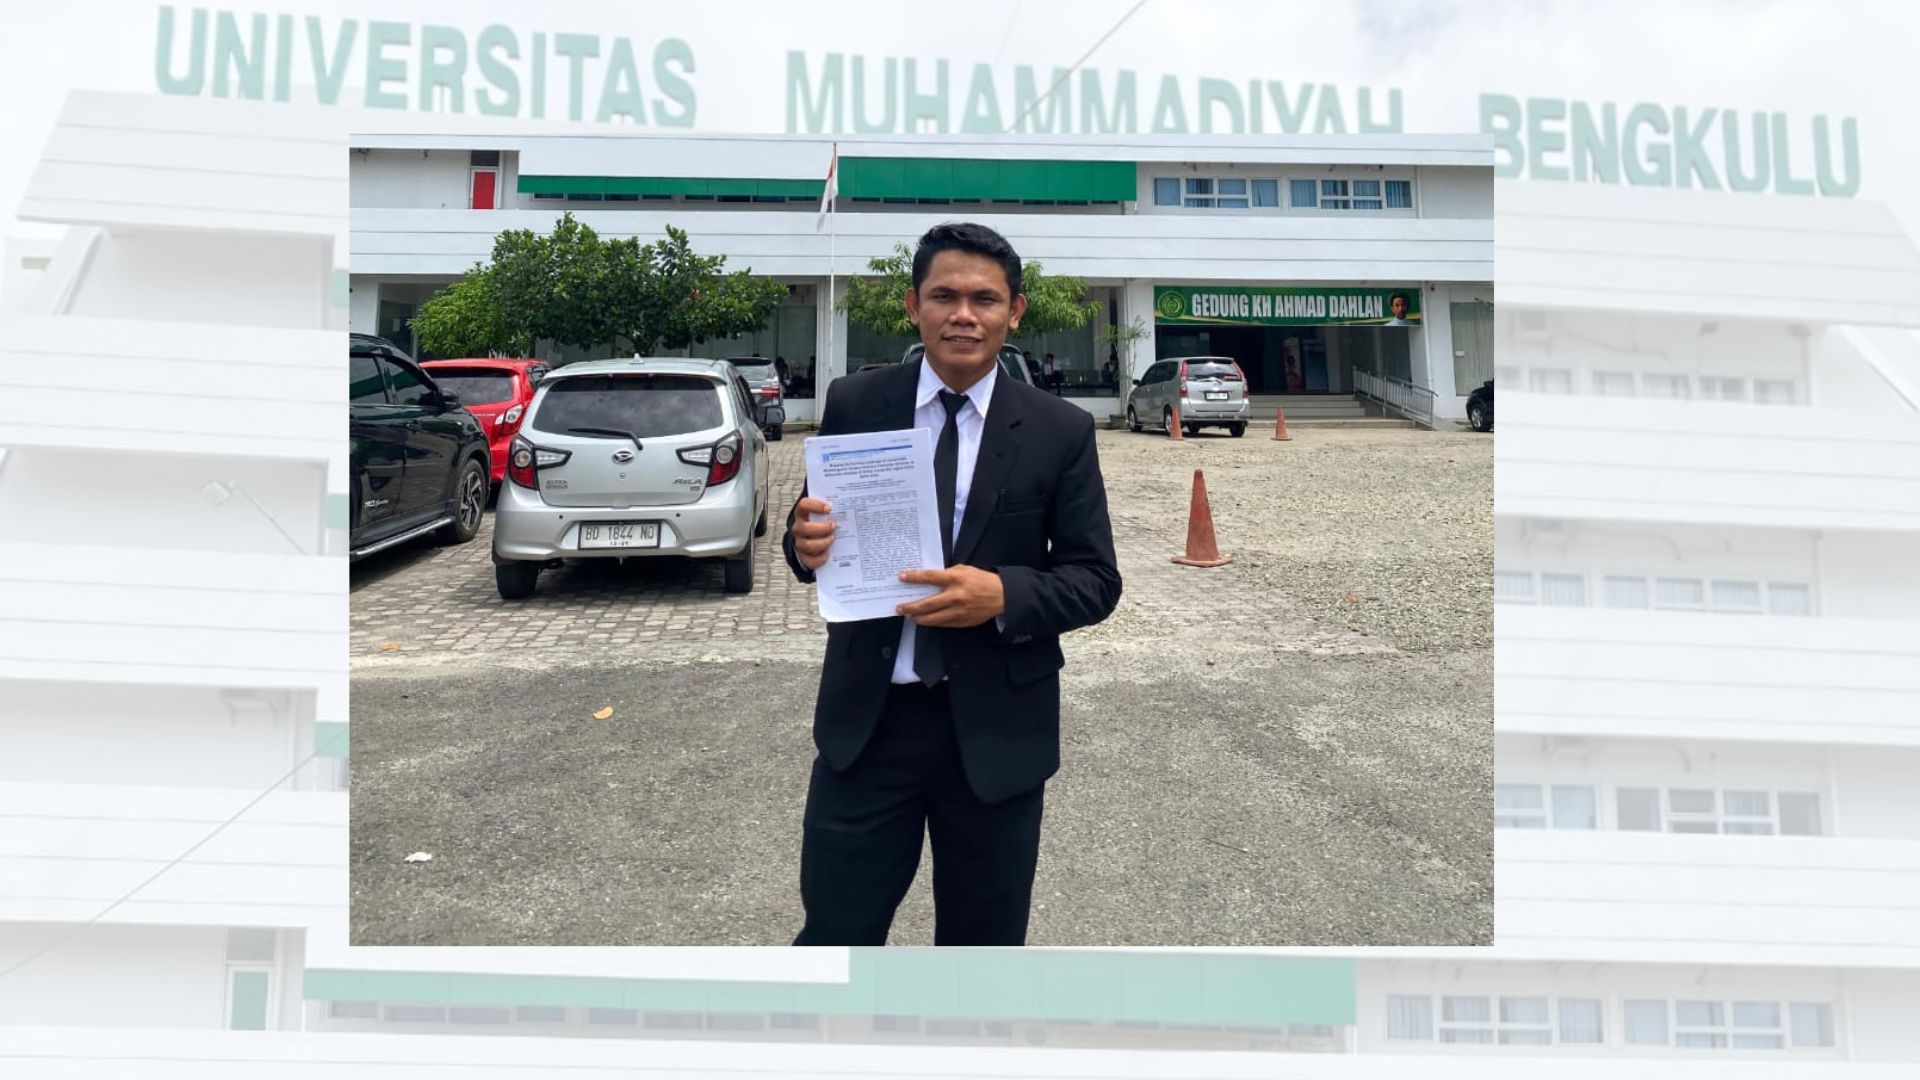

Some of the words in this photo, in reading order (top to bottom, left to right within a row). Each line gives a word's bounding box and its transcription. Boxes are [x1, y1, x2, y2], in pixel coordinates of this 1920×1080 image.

[154, 4, 697, 129] UNIVERSITAS
[785, 50, 1403, 134] MUHAMMADIYAH
[1479, 93, 1861, 199] BENGKULU
[1191, 293, 1249, 317] GEDUNG
[1252, 294, 1272, 317] KH
[1275, 295, 1326, 318] AHMAD
[1329, 295, 1383, 318] DAHLAN
[585, 526, 600, 541] BD
[608, 525, 634, 540] 1844
